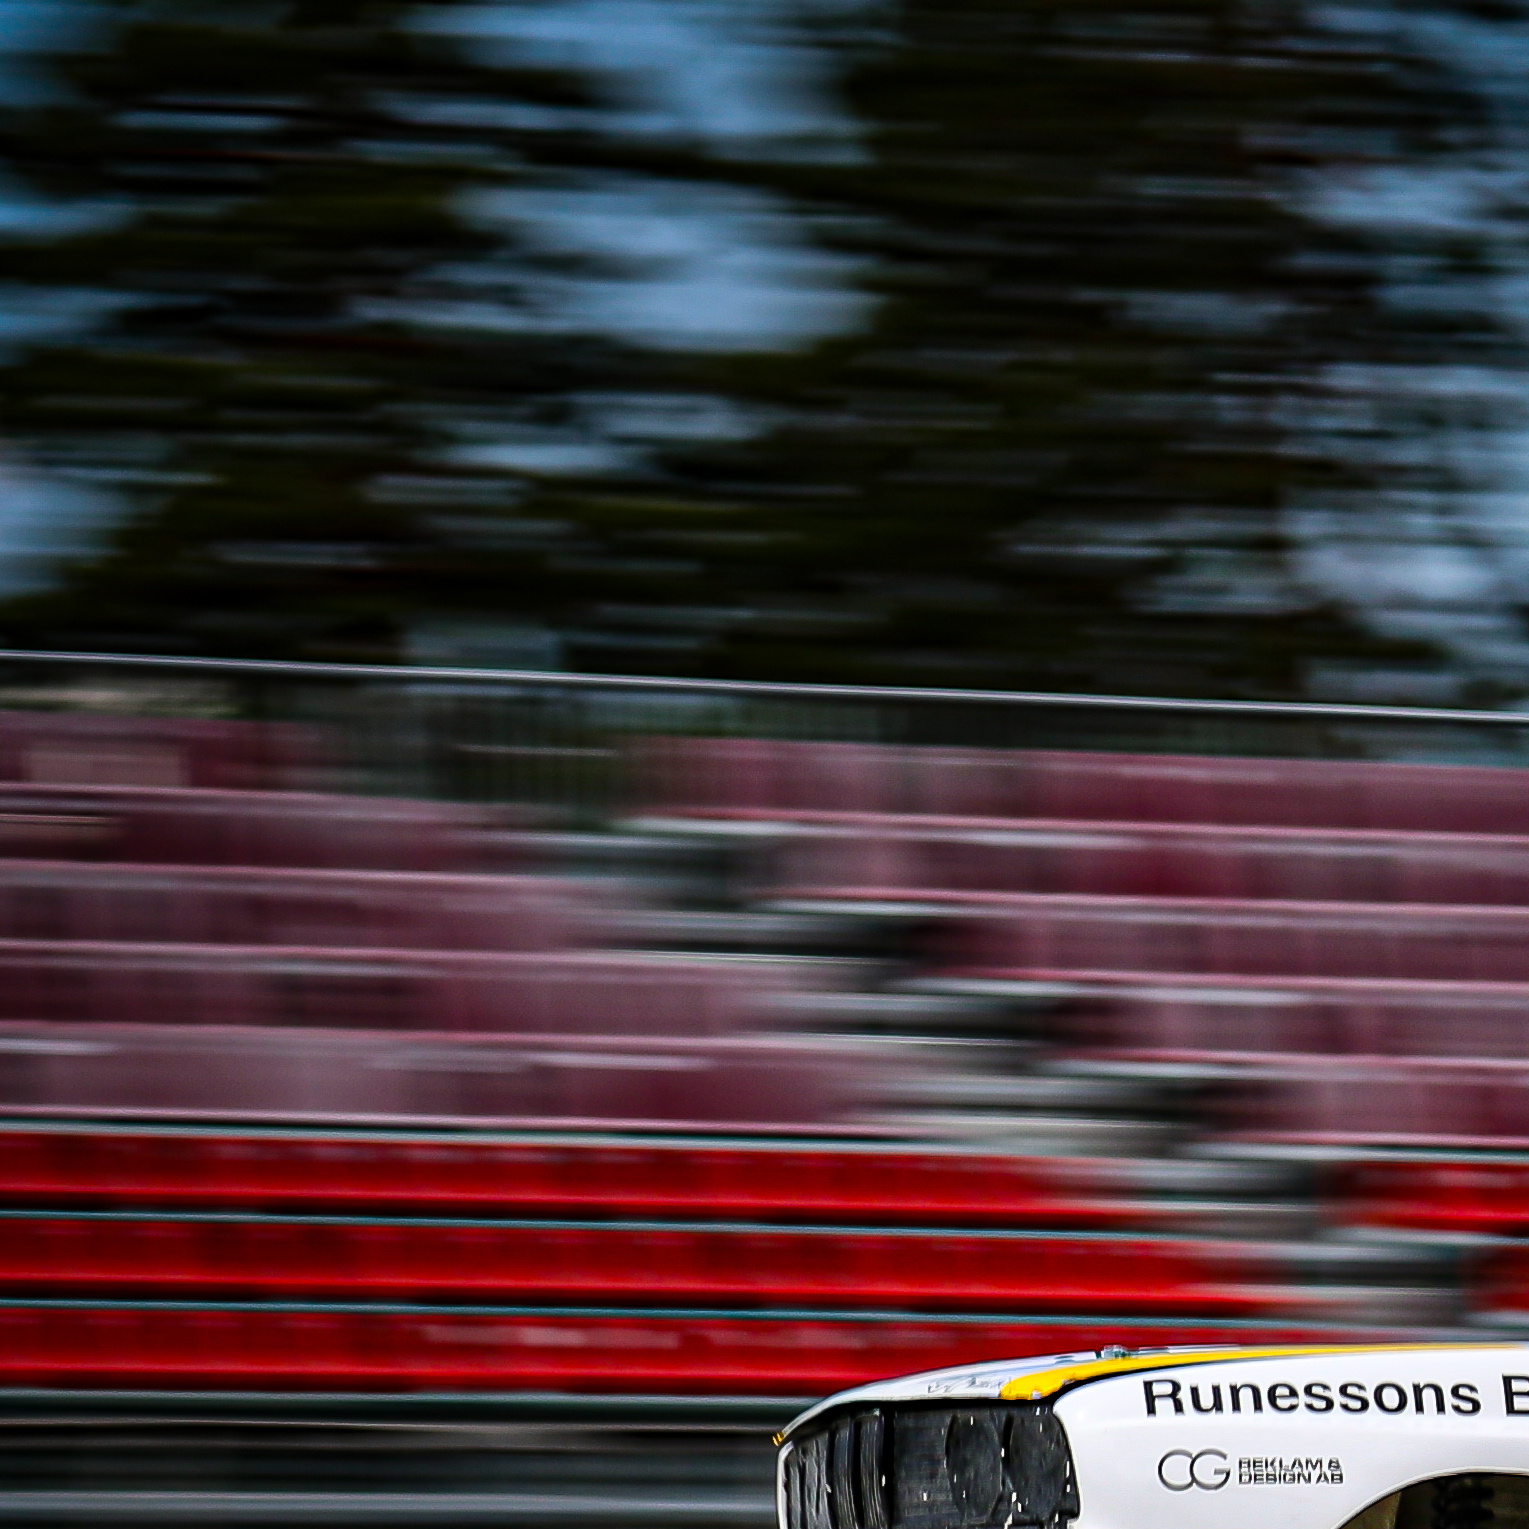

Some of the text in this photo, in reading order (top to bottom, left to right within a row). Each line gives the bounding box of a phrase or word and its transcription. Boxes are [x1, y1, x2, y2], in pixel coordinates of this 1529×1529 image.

[1142, 1378, 1483, 1418] Runessons
[1238, 1456, 1323, 1472] REKLAM
[1238, 1471, 1344, 1485] DESIGN AB
